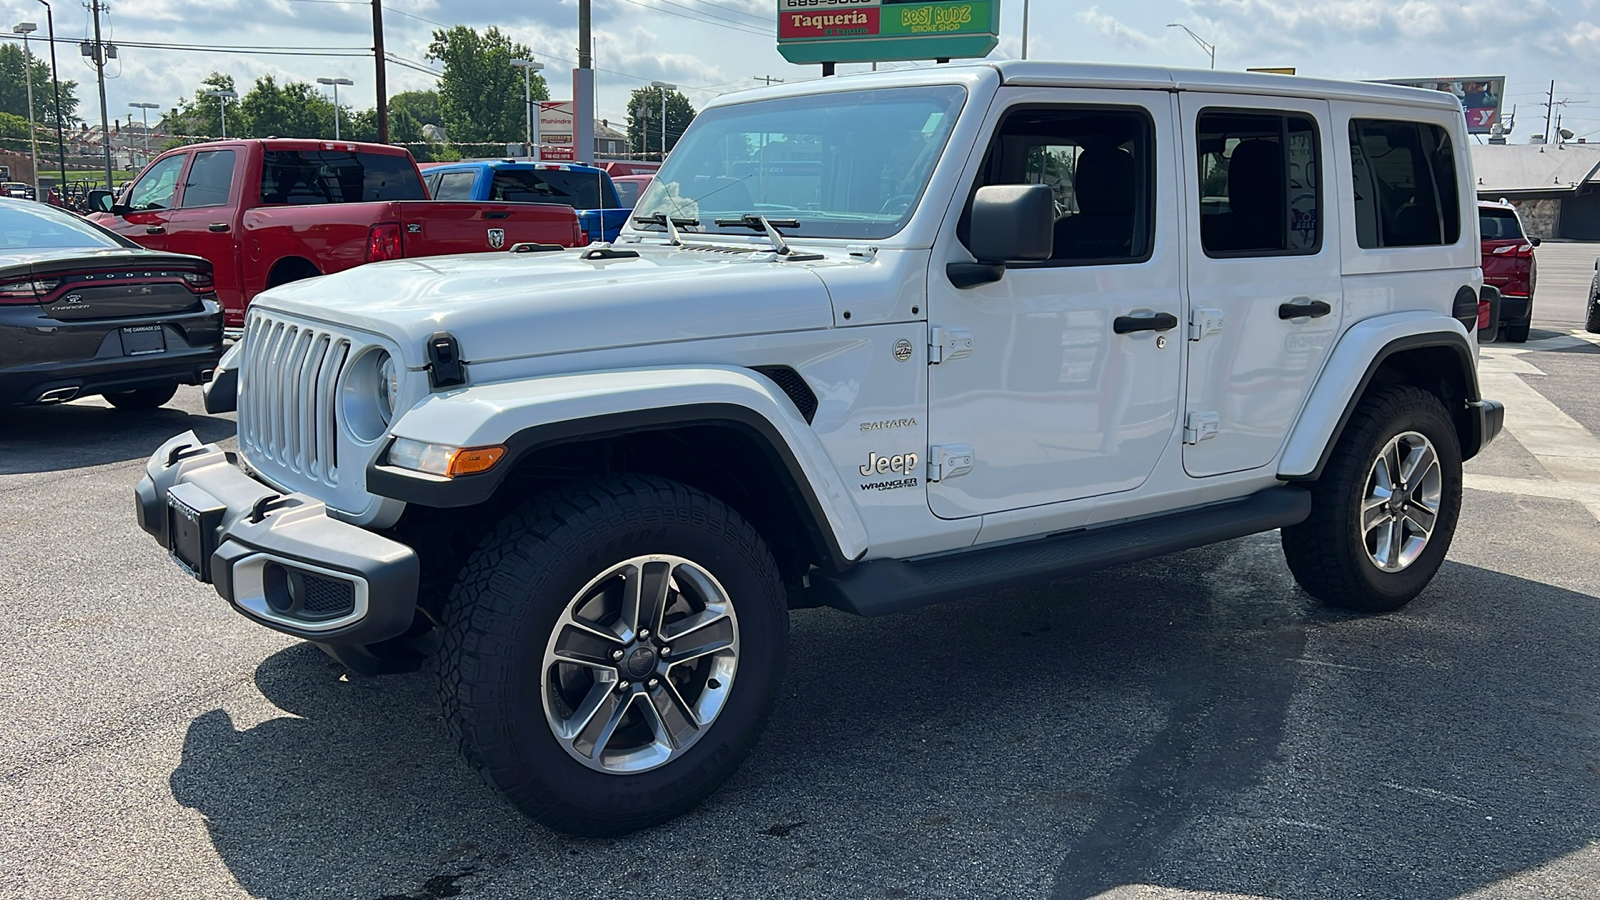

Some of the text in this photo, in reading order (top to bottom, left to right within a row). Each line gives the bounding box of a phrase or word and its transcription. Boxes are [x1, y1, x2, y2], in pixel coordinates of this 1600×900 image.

[935, 5, 971, 23] BUDZ
[939, 23, 960, 32] SHOP
[85, 271, 167, 280] DODGE
[860, 417, 918, 431] SAHARA
[859, 451, 918, 477] Jeep
[860, 477, 918, 490] WRANGLER
